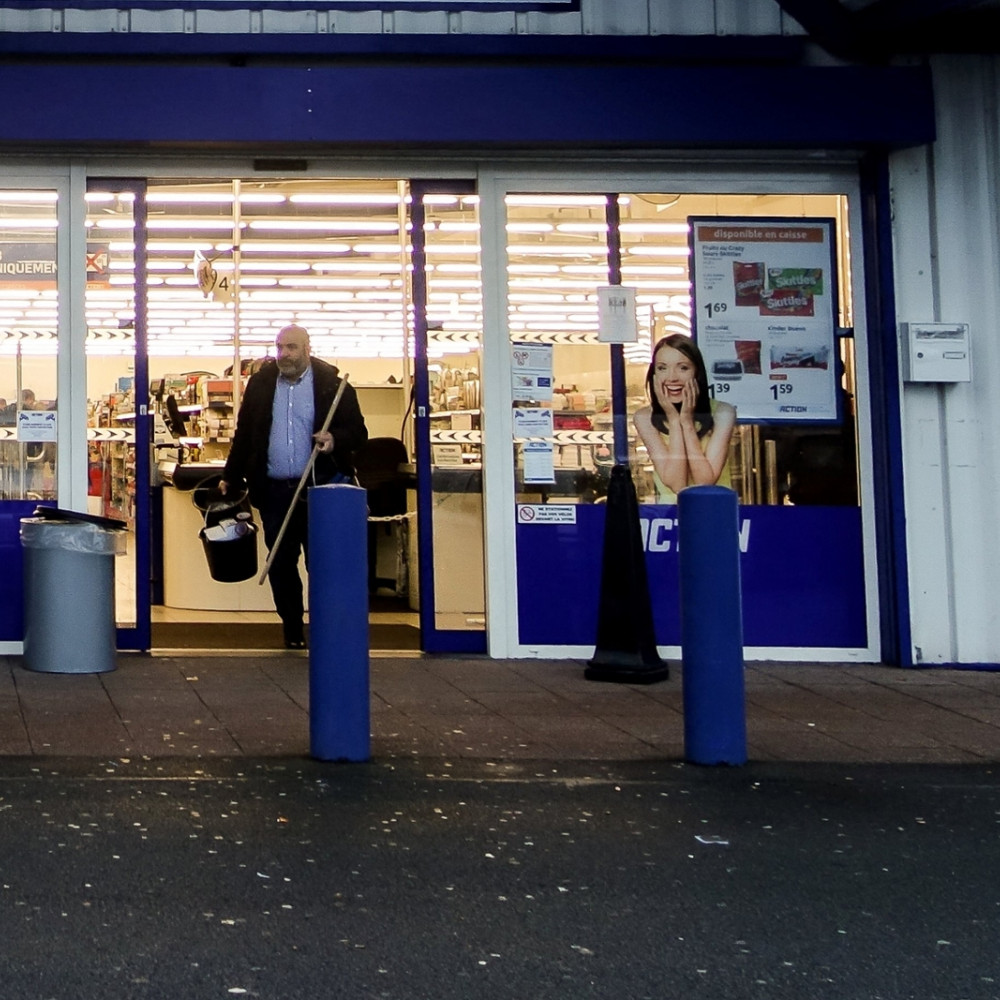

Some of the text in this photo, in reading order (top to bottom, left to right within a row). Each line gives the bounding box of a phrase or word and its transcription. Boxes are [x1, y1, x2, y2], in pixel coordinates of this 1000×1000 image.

[713, 229, 807, 239] disponible en caisse
[218, 276, 229, 291] 4
[775, 274, 817, 288] Skittles
[767, 296, 808, 309] Skittles
[780, 405, 808, 413] ACTION
